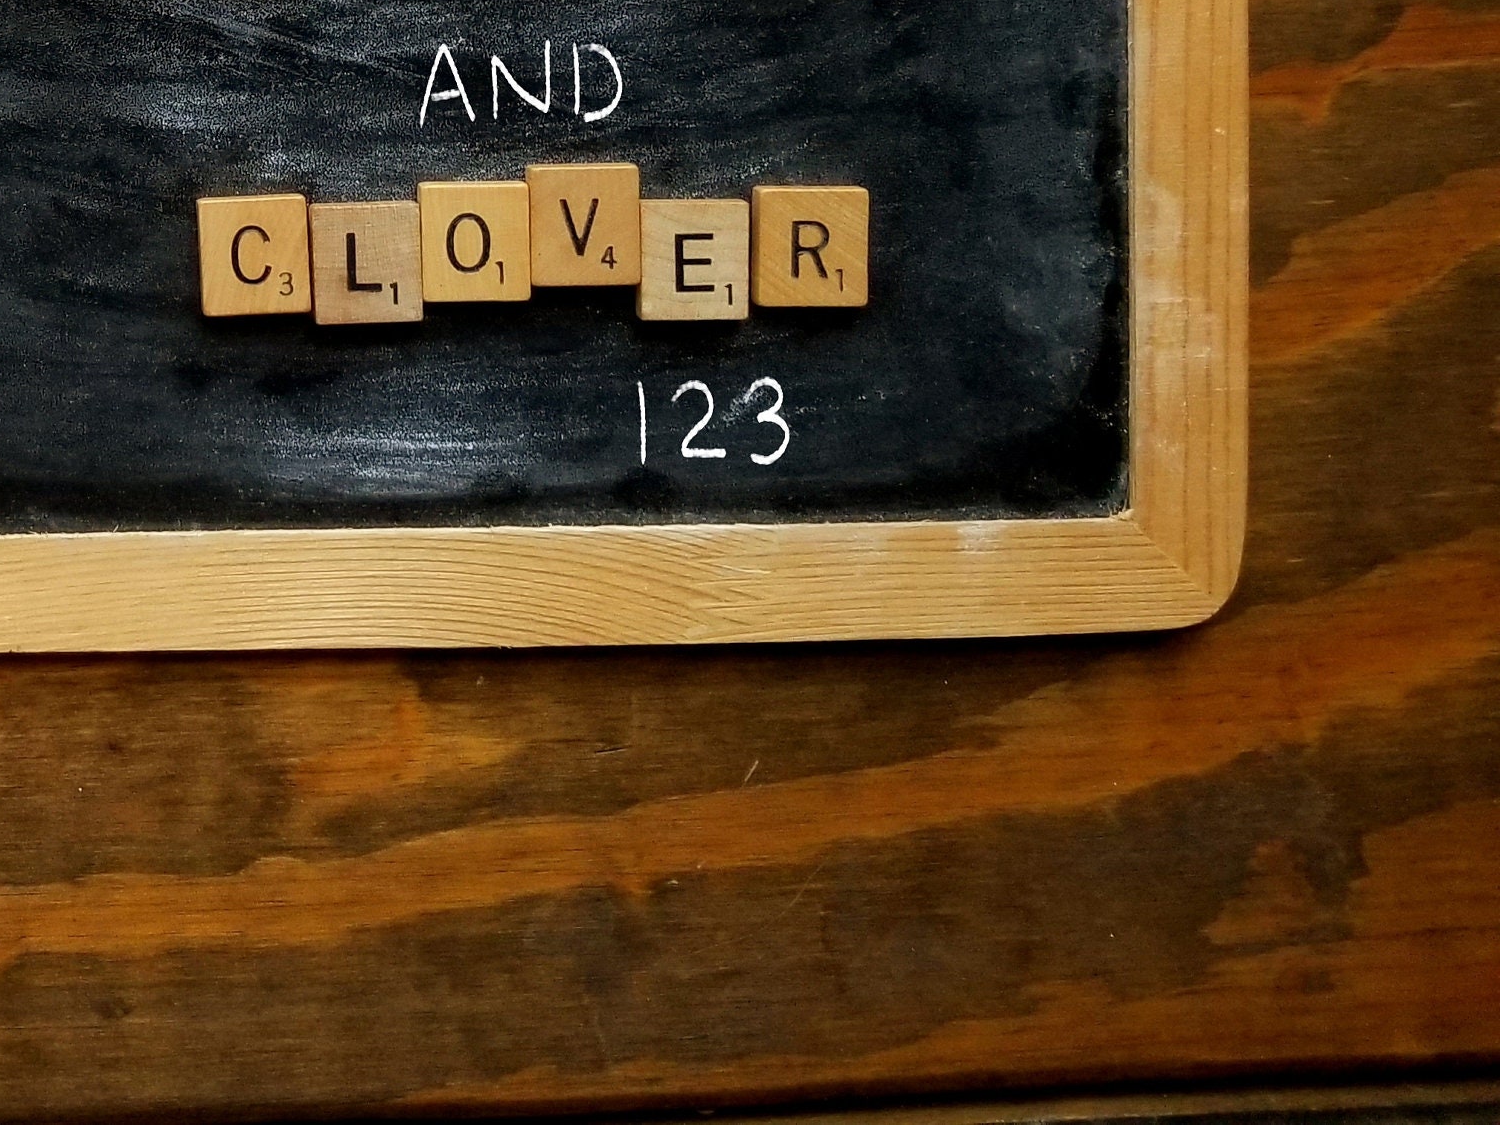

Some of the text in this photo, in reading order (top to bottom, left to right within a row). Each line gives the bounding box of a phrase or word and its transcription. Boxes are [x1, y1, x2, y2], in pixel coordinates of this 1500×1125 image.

[419, 40, 623, 127] AND
[230, 197, 829, 293] CLOVER
[600, 245, 618, 270] 4
[278, 271, 295, 296] 3
[495, 261, 505, 284] 1
[834, 268, 844, 292] 1
[388, 282, 399, 306] 1
[724, 283, 735, 306] 1
[636, 375, 791, 465] 123
